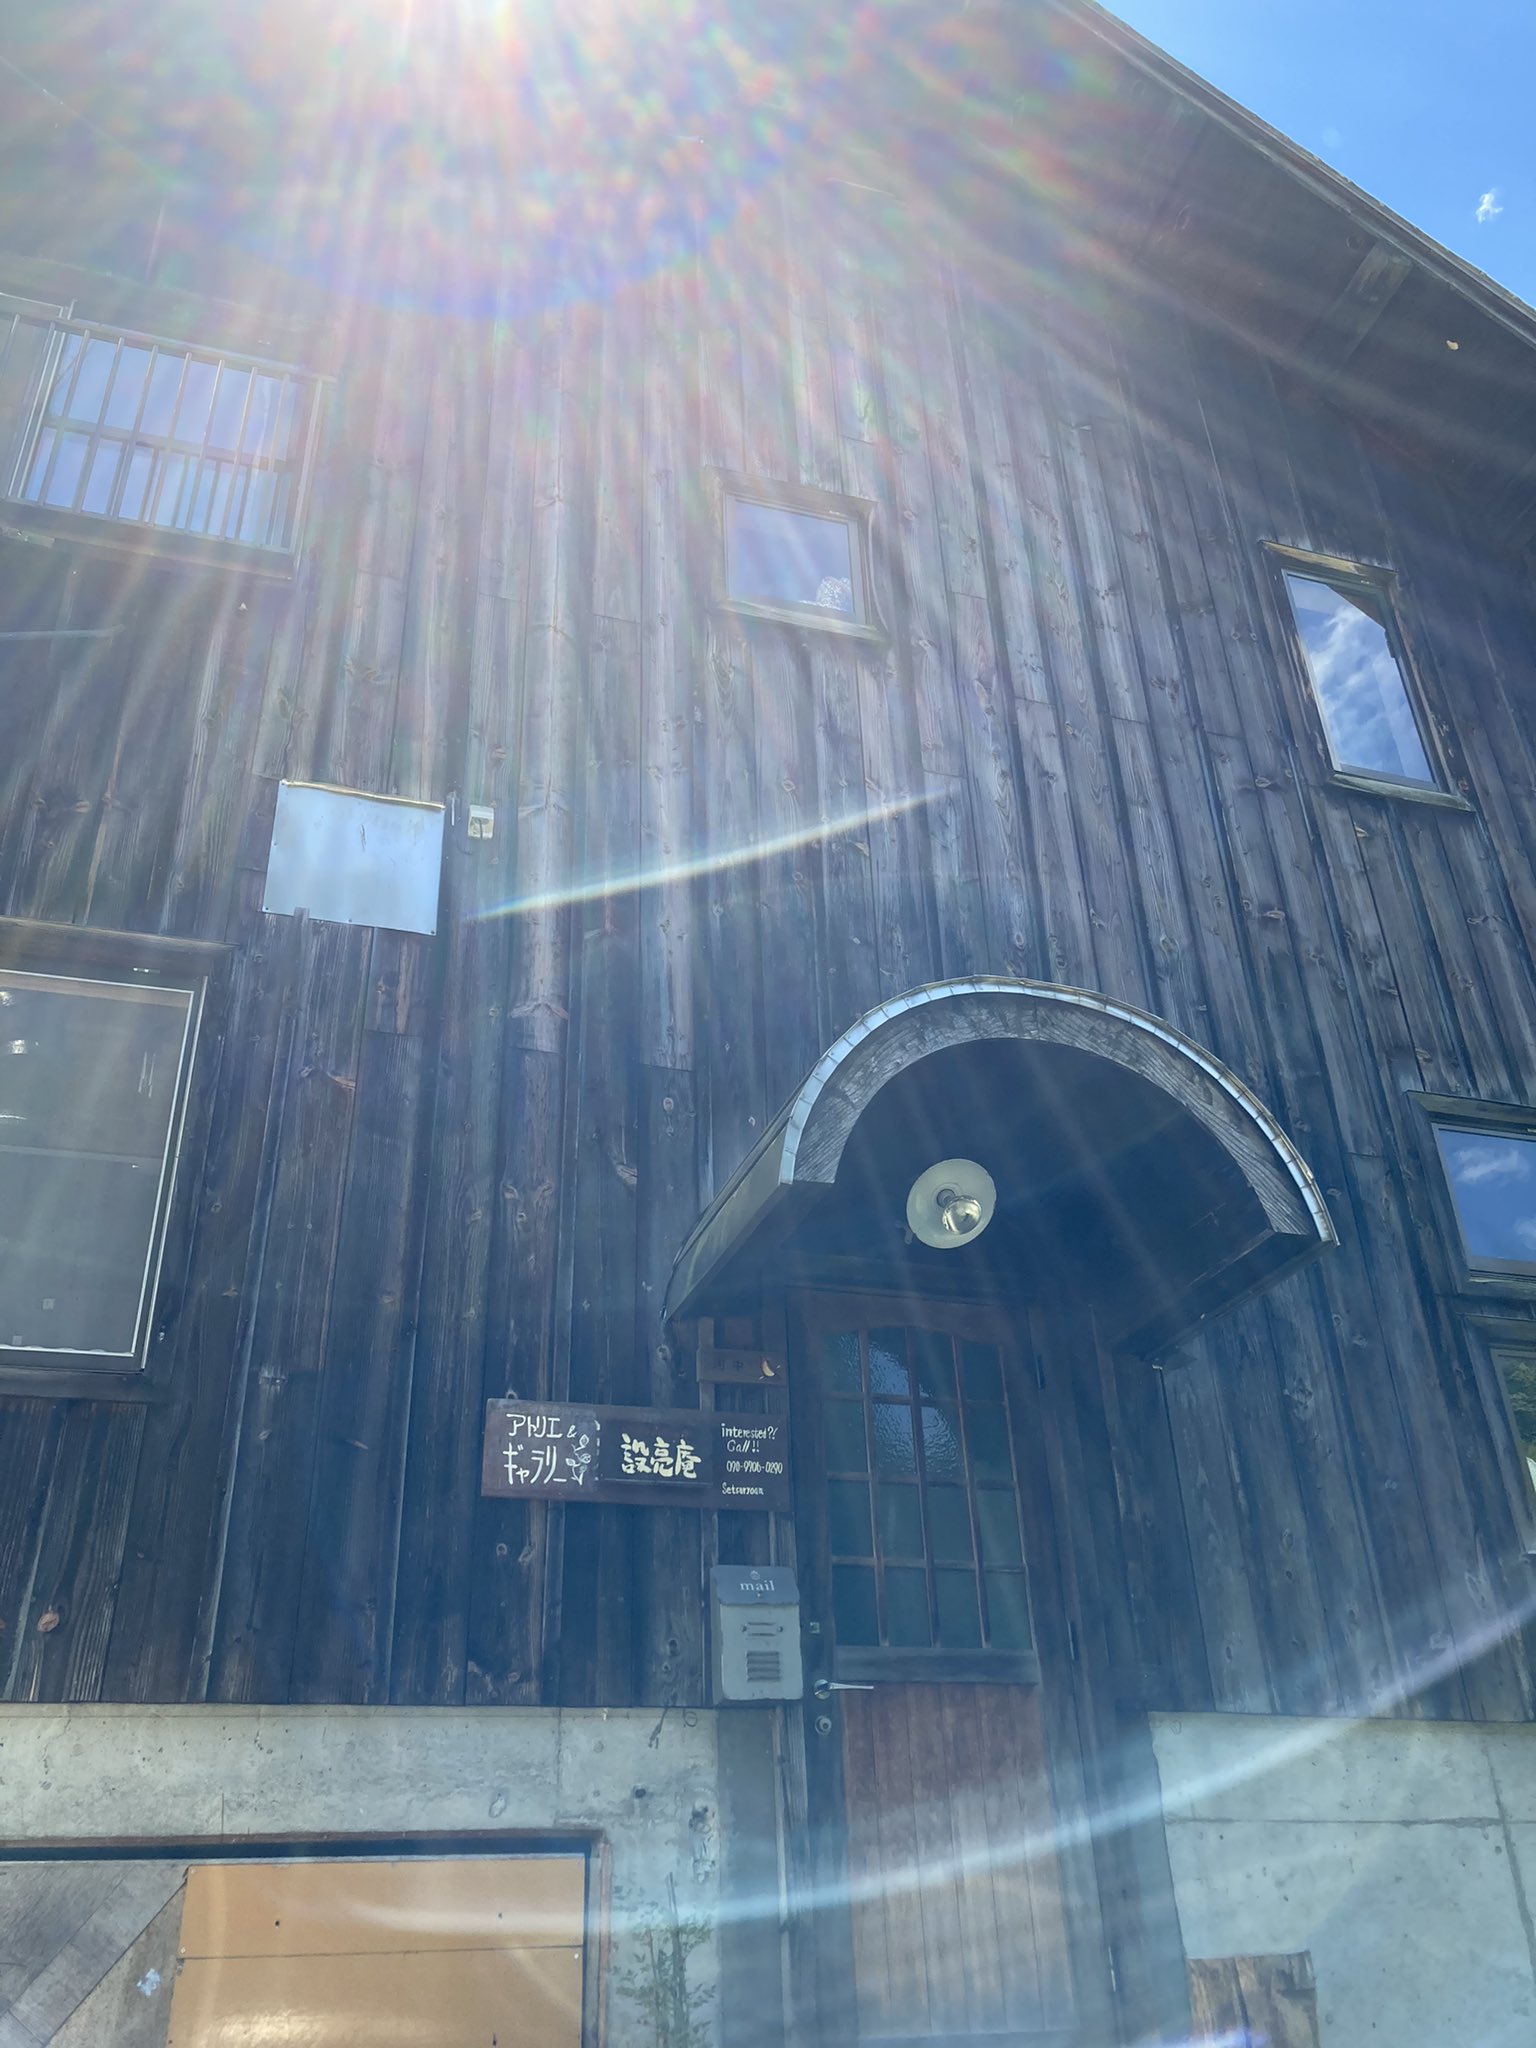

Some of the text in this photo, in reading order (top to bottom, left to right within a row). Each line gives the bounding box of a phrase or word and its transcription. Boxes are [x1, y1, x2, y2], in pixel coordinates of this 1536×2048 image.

[502, 1442, 567, 1485] ギャラリー
[739, 1580, 775, 1591] mail
